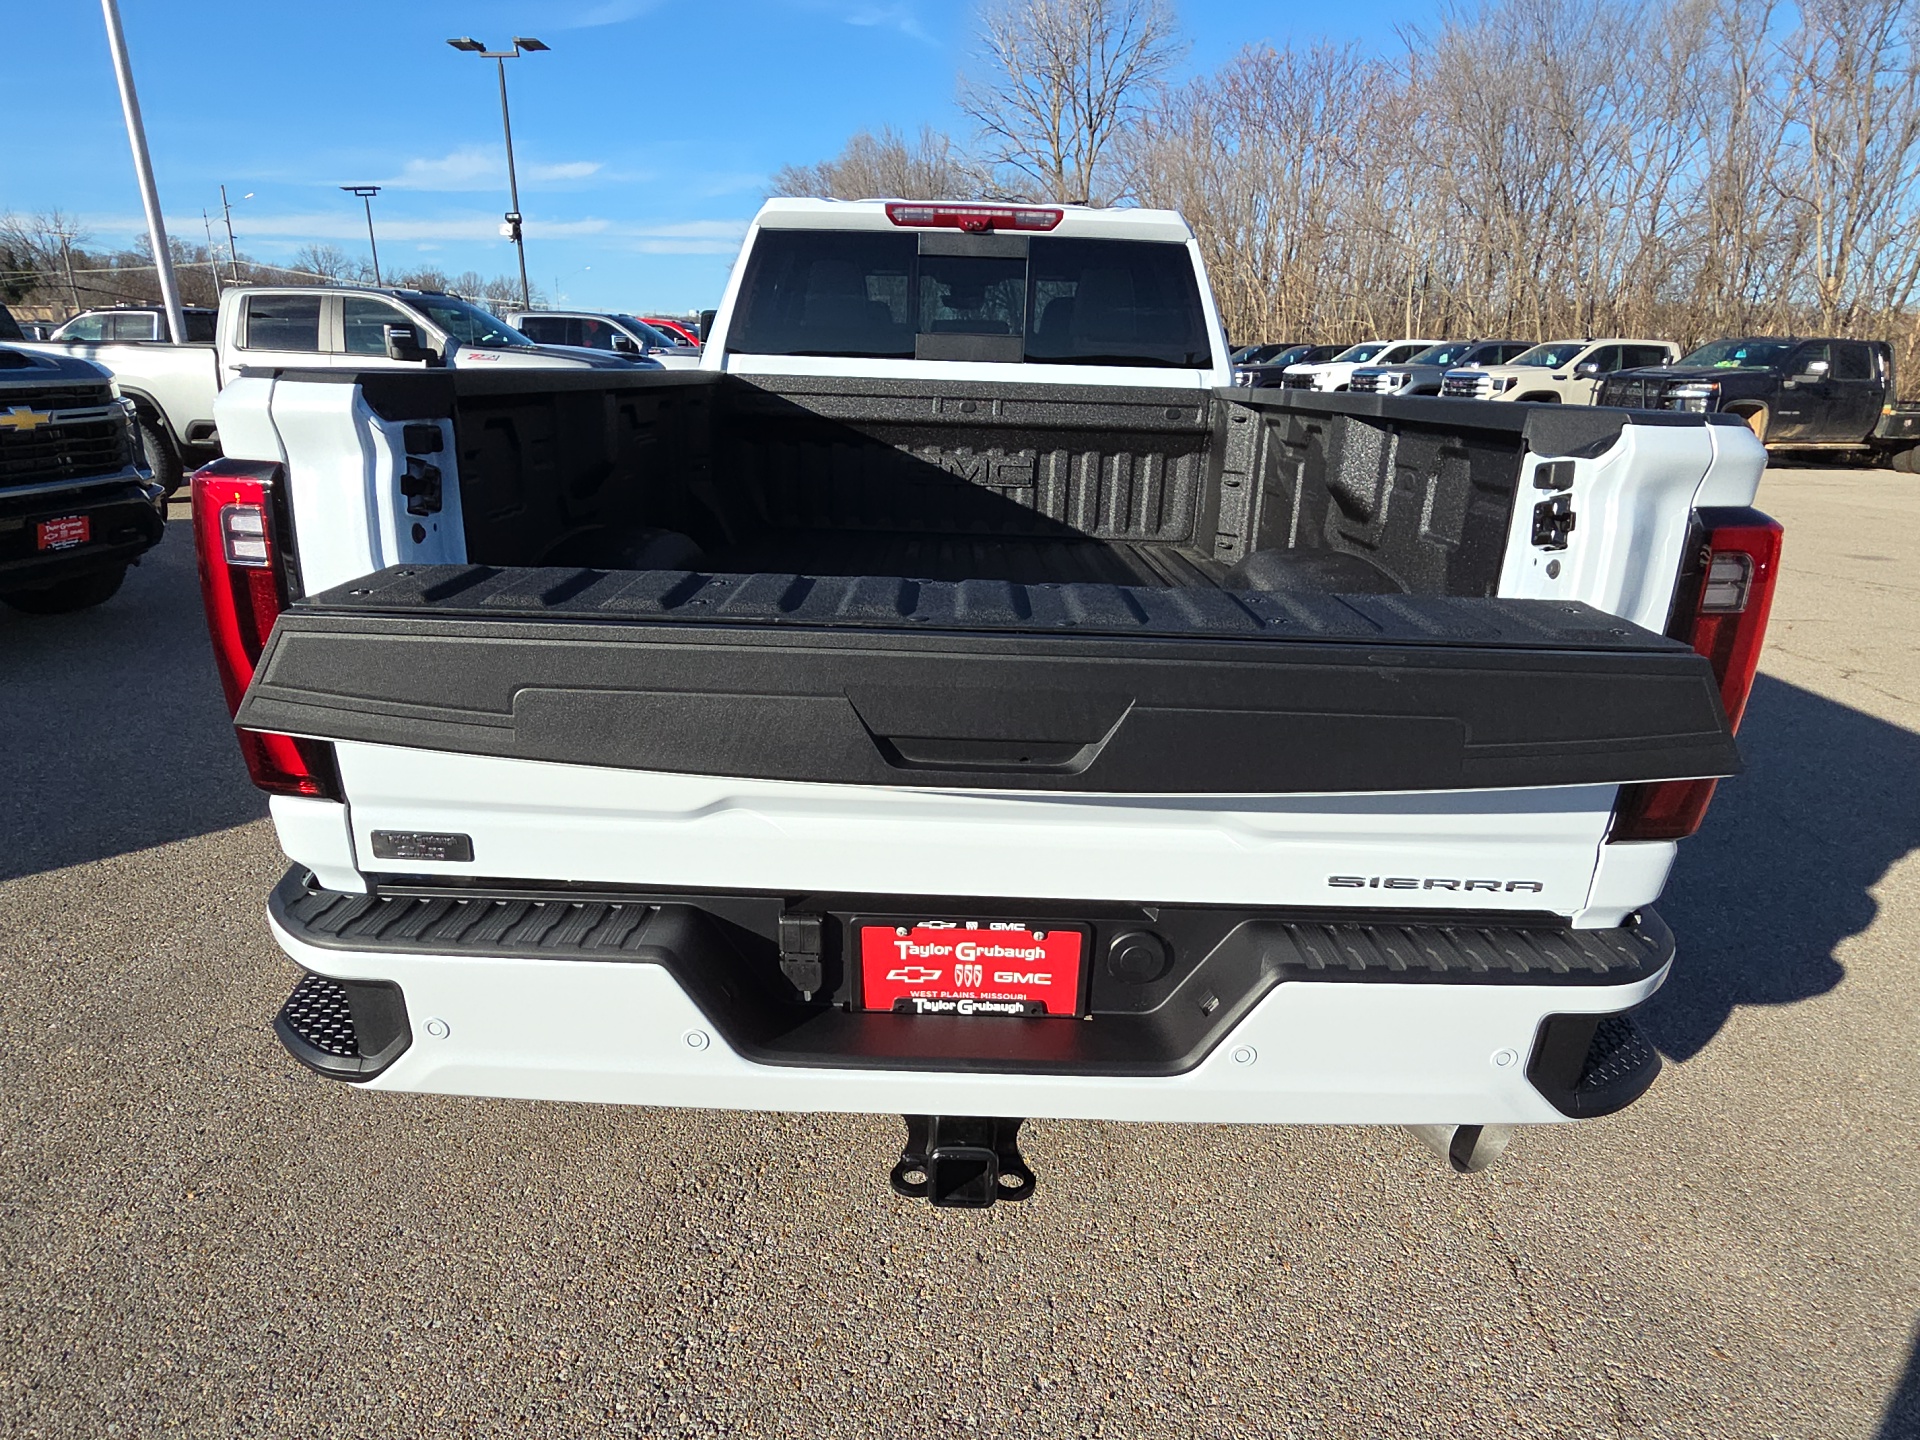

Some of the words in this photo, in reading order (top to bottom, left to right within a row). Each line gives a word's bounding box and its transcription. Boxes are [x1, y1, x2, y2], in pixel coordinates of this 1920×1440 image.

[1328, 876, 1543, 893] SIERRA
[990, 922, 1025, 931] GMC
[894, 940, 952, 960] Taylor
[955, 942, 1045, 961] Grubaugh
[994, 971, 1052, 985] GMC
[910, 990, 938, 998] WEST
[980, 992, 1026, 1000] MISSOURI
[912, 998, 956, 1013] Taylor
[957, 999, 1024, 1014] Grubaugh
